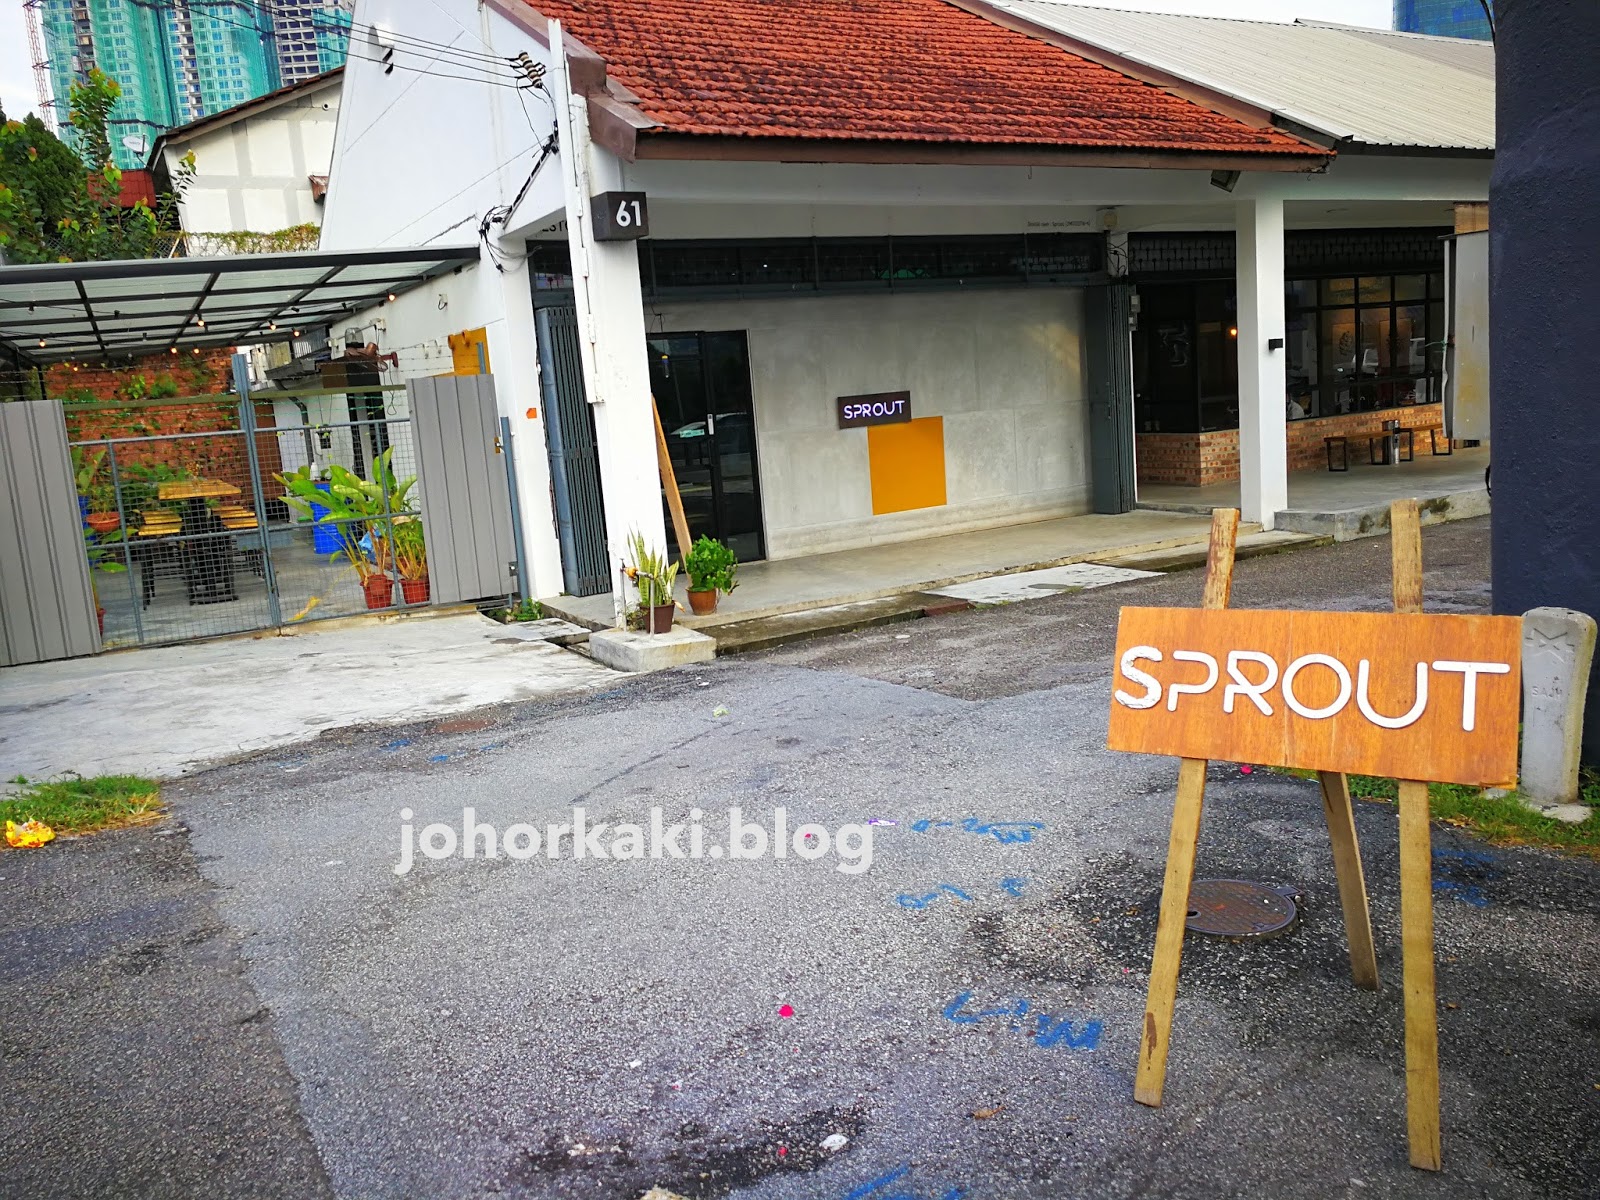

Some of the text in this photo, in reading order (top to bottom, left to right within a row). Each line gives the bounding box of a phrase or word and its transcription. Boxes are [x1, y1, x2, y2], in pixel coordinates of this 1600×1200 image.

[616, 200, 642, 227] 61
[843, 400, 906, 419] SPROUT
[1114, 645, 1511, 732] SPROUT
